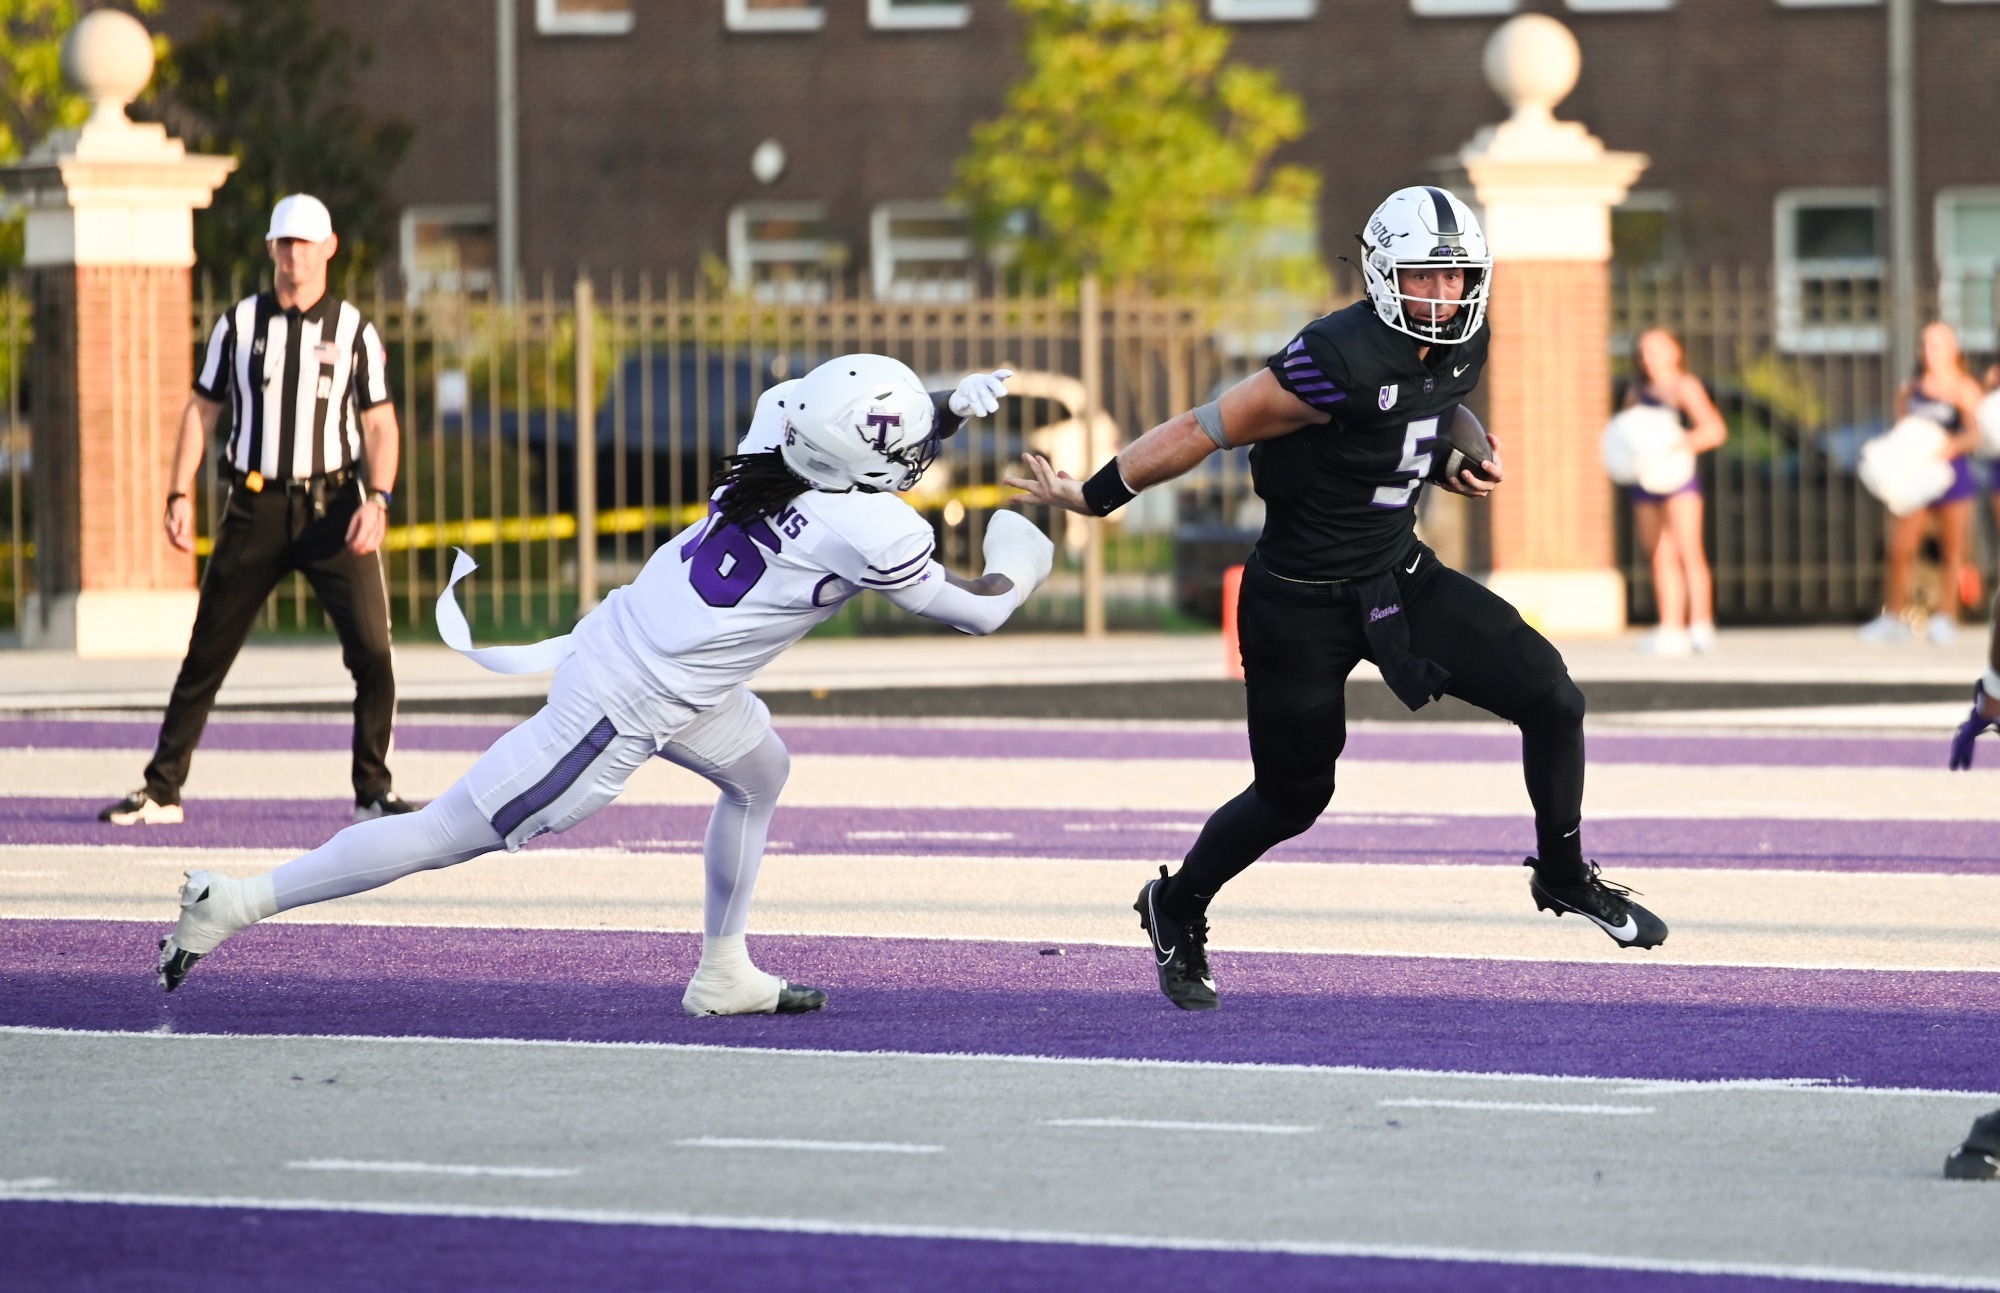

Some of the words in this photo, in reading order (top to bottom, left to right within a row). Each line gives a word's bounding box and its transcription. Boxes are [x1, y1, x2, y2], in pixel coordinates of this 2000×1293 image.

[866, 410, 902, 451] T
[1369, 415, 1440, 508] 5
[772, 505, 809, 540] NS
[1369, 603, 1400, 622] Bears
